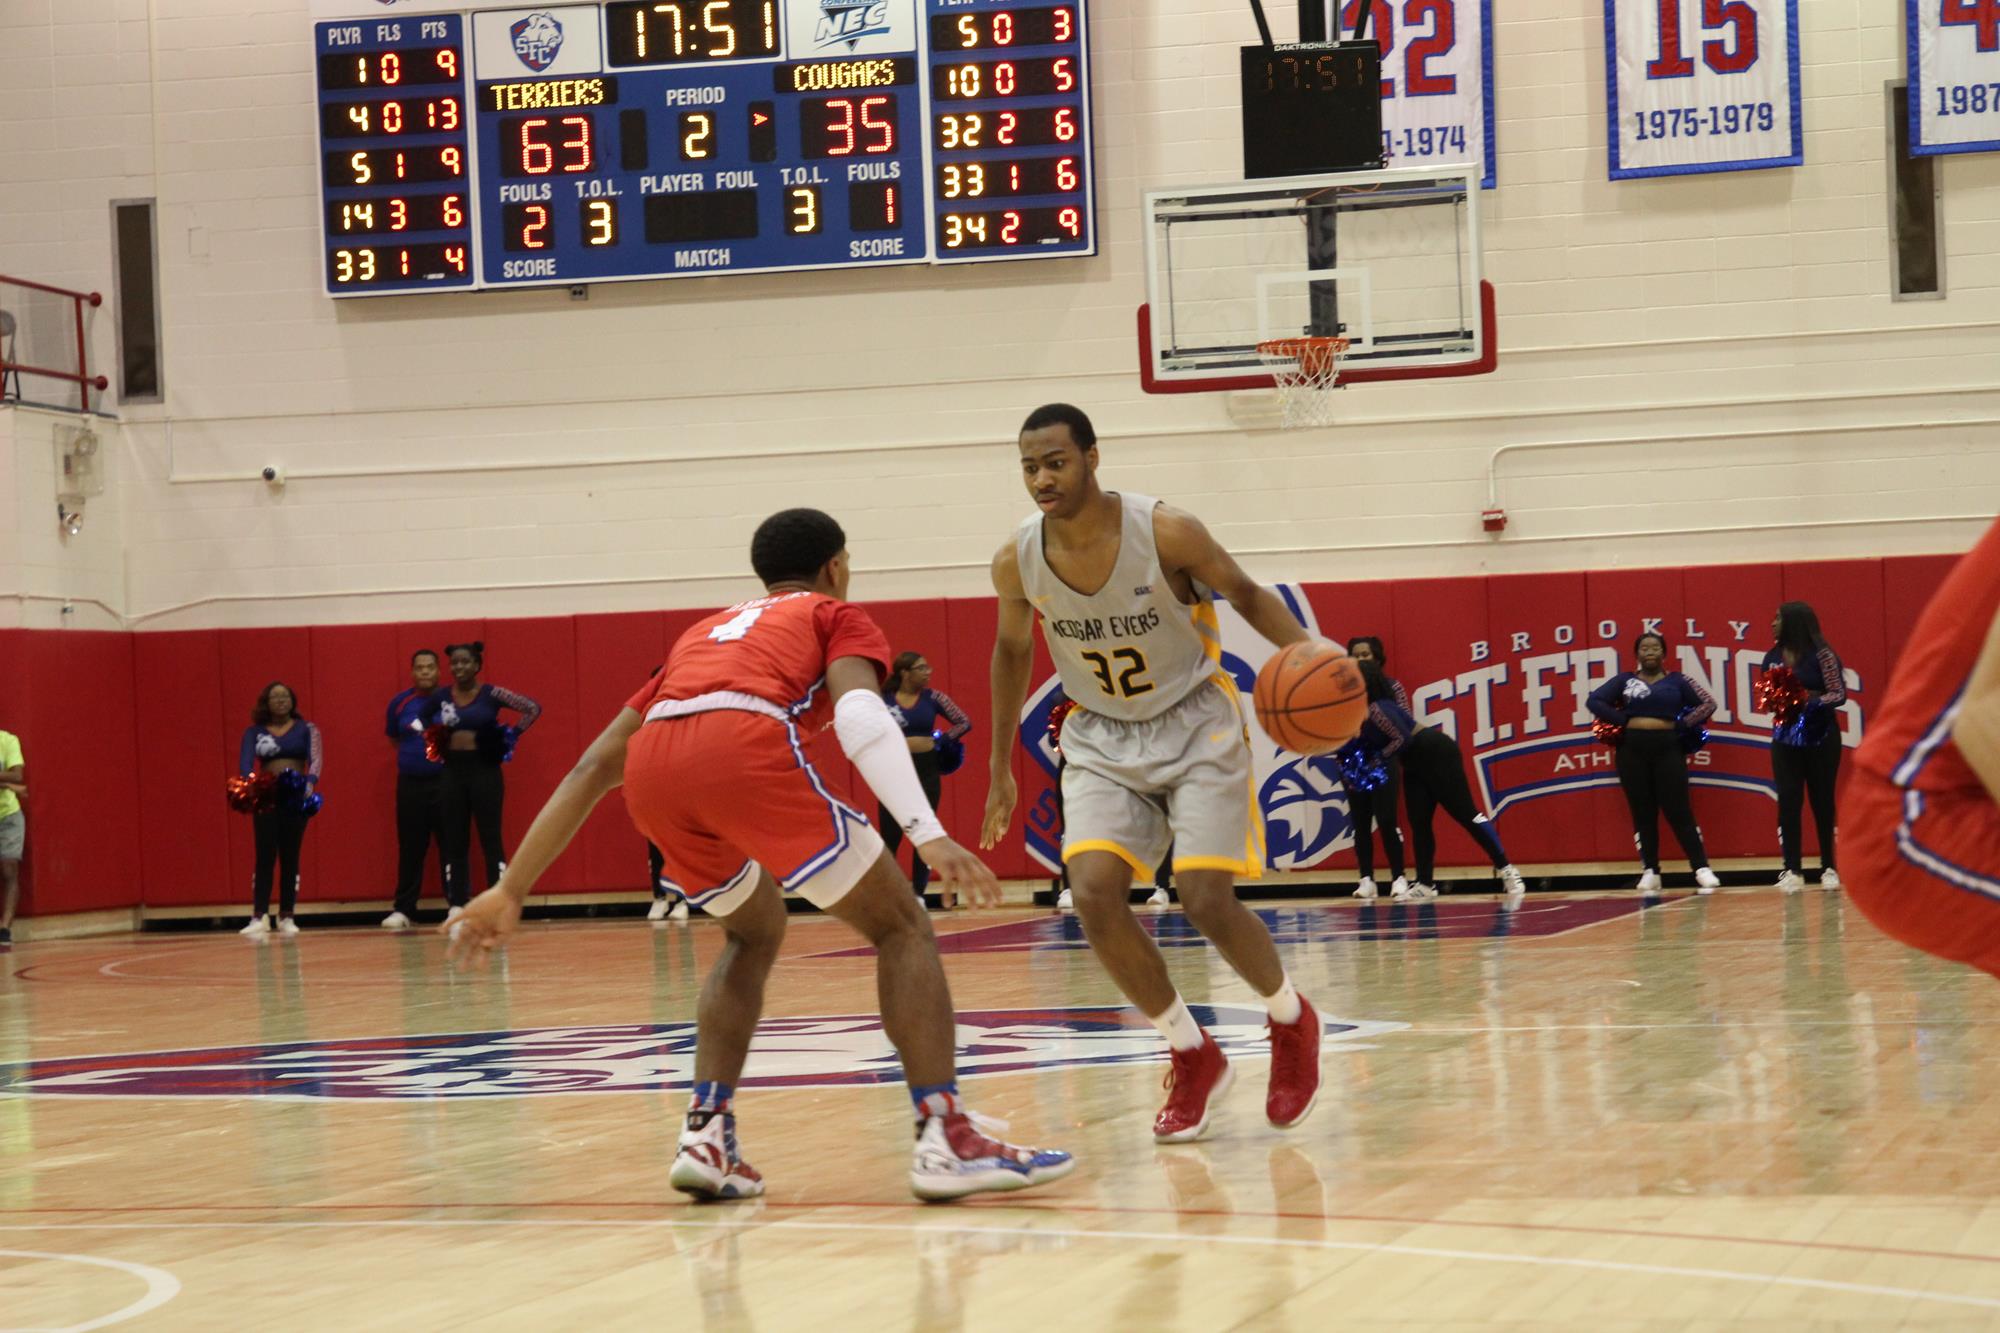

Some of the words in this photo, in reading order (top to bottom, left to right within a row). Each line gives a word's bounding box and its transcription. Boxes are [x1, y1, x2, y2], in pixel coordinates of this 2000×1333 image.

[328, 27, 362, 46] PLYR
[377, 24, 401, 42] FLS
[421, 21, 447, 39] PTS
[636, 2, 773, 58] 17:51
[814, 1, 888, 42] NEC
[958, 15, 977, 47] 5
[993, 13, 1012, 45] 0
[1053, 9, 1071, 41] 3
[515, 36, 552, 64] SFC
[1274, 41, 1340, 52] DAKTRONICS
[1646, 0, 1759, 80] 15
[358, 57, 367, 83] 1
[380, 52, 399, 84] 0
[437, 50, 456, 78] 9
[793, 59, 895, 91] COUGARS
[948, 64, 980, 97] 10
[995, 63, 1014, 95] 0
[1053, 59, 1072, 91] 5
[1267, 55, 1363, 91] 17:51
[490, 79, 603, 111] TERRIERS
[666, 86, 725, 106] PERIOD
[350, 105, 369, 132] 4
[383, 101, 402, 133] 0
[427, 98, 458, 130] 13
[826, 97, 892, 155] 35
[942, 115, 982, 148] 32
[998, 113, 1016, 145] 2
[1055, 109, 1074, 141] 6
[1635, 102, 1774, 141] 1975-1979
[521, 116, 590, 174] 63
[684, 115, 709, 159] 2
[1381, 125, 1466, 158] 1-1974
[351, 152, 371, 184] 5
[397, 153, 405, 179] 1
[441, 147, 460, 175] 9
[640, 173, 703, 194] PLAYER
[716, 170, 758, 189] FOUL
[780, 165, 829, 185] T.O.L.
[847, 161, 900, 181] FOULS
[943, 164, 983, 198] 33
[1011, 165, 1018, 191] 1
[1057, 158, 1076, 191] 6
[500, 182, 552, 202] FOULS
[575, 180, 623, 198] T.O.L.
[886, 187, 894, 224] 1
[343, 203, 373, 231] 14
[389, 199, 406, 230] 3
[443, 196, 462, 227] 6
[523, 205, 546, 249] 2
[590, 201, 611, 246] 3
[793, 188, 815, 233] 3
[945, 215, 986, 247] 34
[1001, 211, 1020, 244] 2
[1059, 208, 1078, 237] 9
[336, 249, 376, 282] 33
[400, 251, 408, 275] 1
[445, 247, 464, 273] 4
[675, 248, 730, 268] MATCH
[850, 238, 904, 258] SCORE
[503, 258, 556, 278] SCORE
[1109, 607, 1160, 638] EVERS
[1470, 618, 1750, 663] BROOKLY
[1080, 646, 1155, 698] 32
